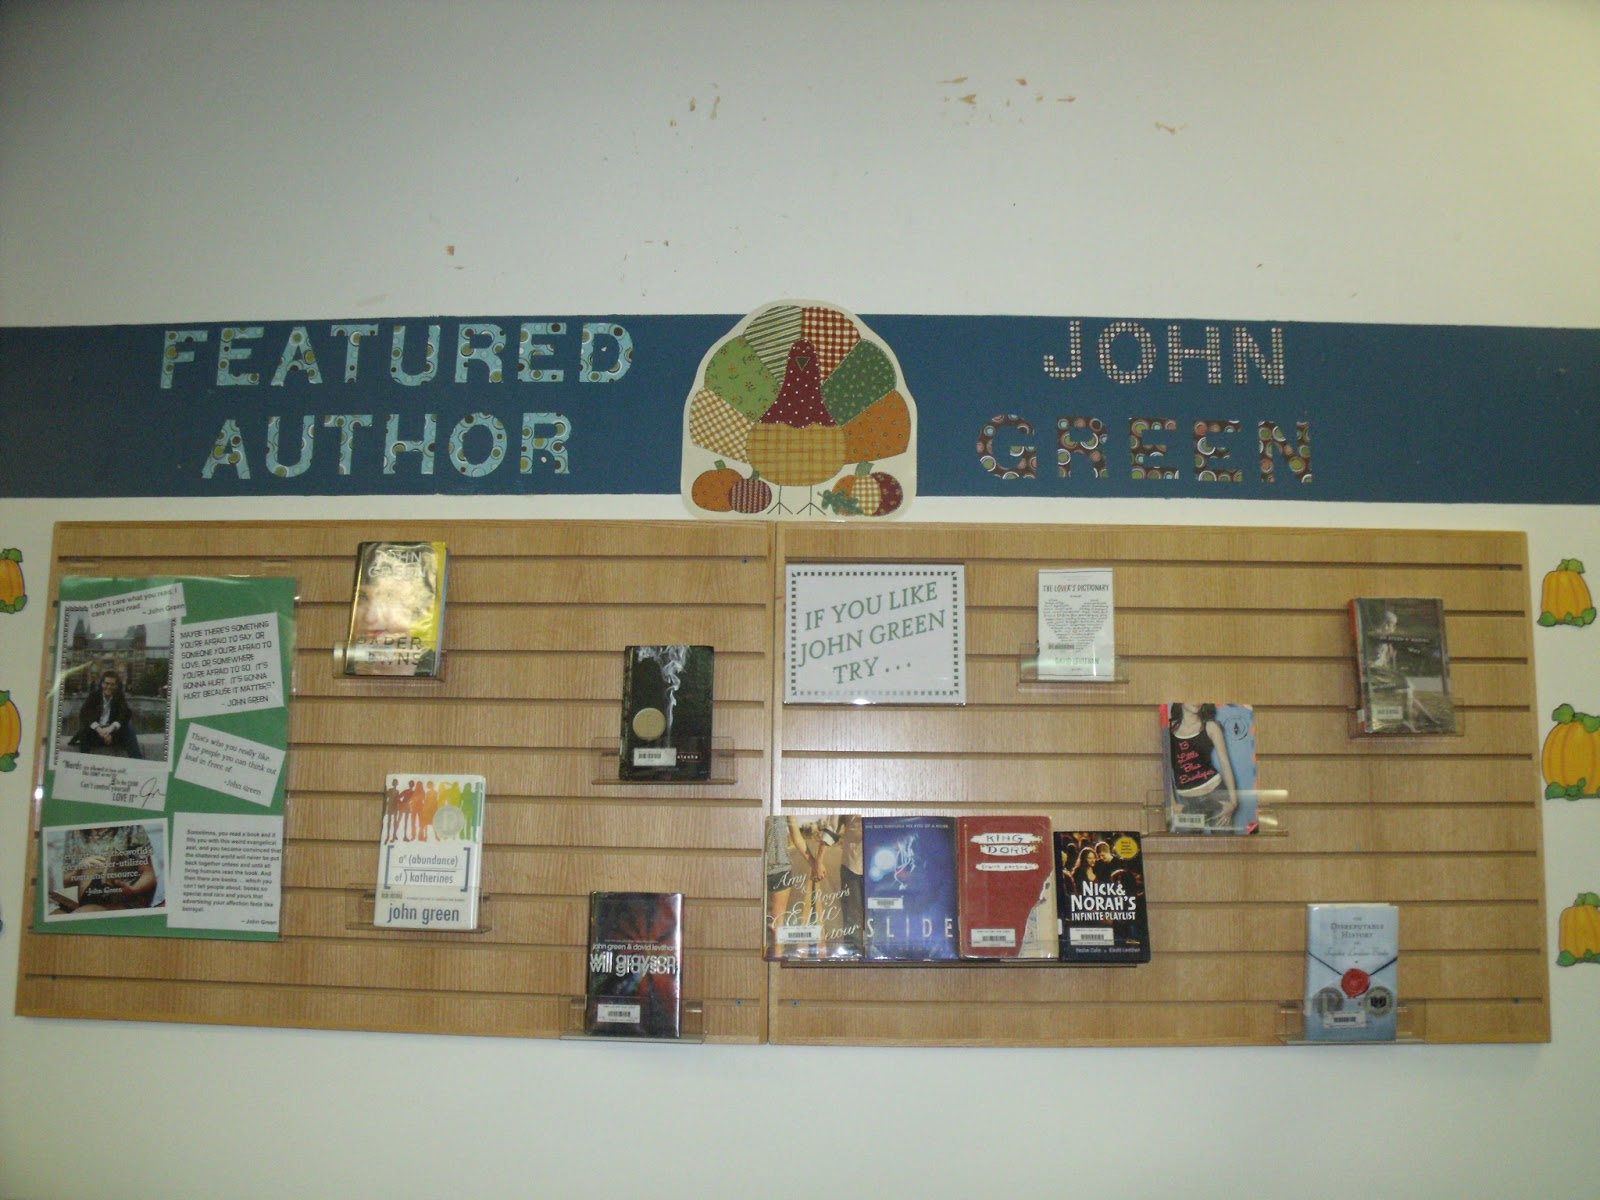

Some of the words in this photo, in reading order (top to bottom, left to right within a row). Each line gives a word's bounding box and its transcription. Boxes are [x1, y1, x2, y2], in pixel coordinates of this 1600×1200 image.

[160, 323, 633, 389] FEATURED
[1043, 320, 1285, 386] JOHN
[201, 411, 573, 479] AUTHOR
[976, 414, 1313, 483] GREEN
[376, 550, 422, 565] OHN
[1077, 584, 1109, 592] DICTIONARY
[94, 600, 111, 609] don't
[112, 598, 125, 606] care
[128, 594, 143, 602] what
[148, 607, 164, 615] John
[165, 603, 185, 612] Green
[805, 609, 824, 631] IF
[832, 595, 882, 623] YOU
[889, 582, 938, 610] LIKE
[91, 610, 105, 618] care
[180, 630, 202, 639] MAYBE
[204, 626, 229, 635] THERE'S
[231, 621, 269, 632] SOMETHING
[798, 630, 863, 667] JOHN
[870, 610, 945, 645] GREEN
[180, 640, 202, 649] YOU'RE
[204, 637, 227, 645] AFRAID
[229, 635, 238, 643] TO
[255, 631, 265, 639] OR
[181, 649, 212, 659] SOMEONE
[214, 646, 236, 654] YOU'RE
[238, 642, 260, 651] AFRAID
[213, 653, 254, 665] SOMEWHERE
[182, 671, 205, 680] YOU'RE
[206, 668, 229, 676] AFRAID
[231, 666, 239, 674] TO
[256, 661, 268, 671] IT'S
[833, 657, 878, 684] TRY
[183, 680, 206, 690] GONNA
[230, 675, 242, 684] IT'S
[244, 673, 267, 682] GONNA
[183, 691, 201, 700] HURT
[203, 687, 231, 698] BECAUSE
[227, 698, 246, 707] JOHN
[248, 695, 268, 704] GREEN
[192, 732, 209, 743] That's
[211, 738, 224, 747] who
[225, 744, 238, 752] you
[239, 748, 257, 758] really
[185, 753, 199, 763] loud
[207, 759, 223, 770] front
[189, 743, 200, 751] The
[200, 747, 221, 758] people
[222, 753, 233, 761] you
[235, 758, 247, 766] can
[248, 761, 264, 771] think
[112, 792, 127, 802] LOVE
[243, 784, 261, 795] Green
[986, 834, 1024, 844] KING
[988, 846, 1029, 854] DORK
[409, 854, 458, 867] (abundance)
[107, 871, 140, 879] resource.
[394, 873, 403, 883] of
[410, 871, 454, 884] katherines
[773, 871, 807, 890] Amy
[811, 883, 850, 907] Roger's
[1071, 894, 1137, 912] NORAH'S
[387, 903, 417, 924] john
[422, 908, 459, 925] green
[767, 901, 841, 928] Epic
[1071, 912, 1103, 921] INFINITE
[1105, 911, 1136, 920] PLAYLIST
[825, 924, 861, 940] etour
[866, 918, 953, 938] SLIDE
[592, 943, 607, 952] john
[633, 943, 652, 951] david
[590, 951, 613, 963] will
[616, 954, 676, 968] grayson
[590, 961, 613, 973] will
[616, 962, 676, 977] grayson
